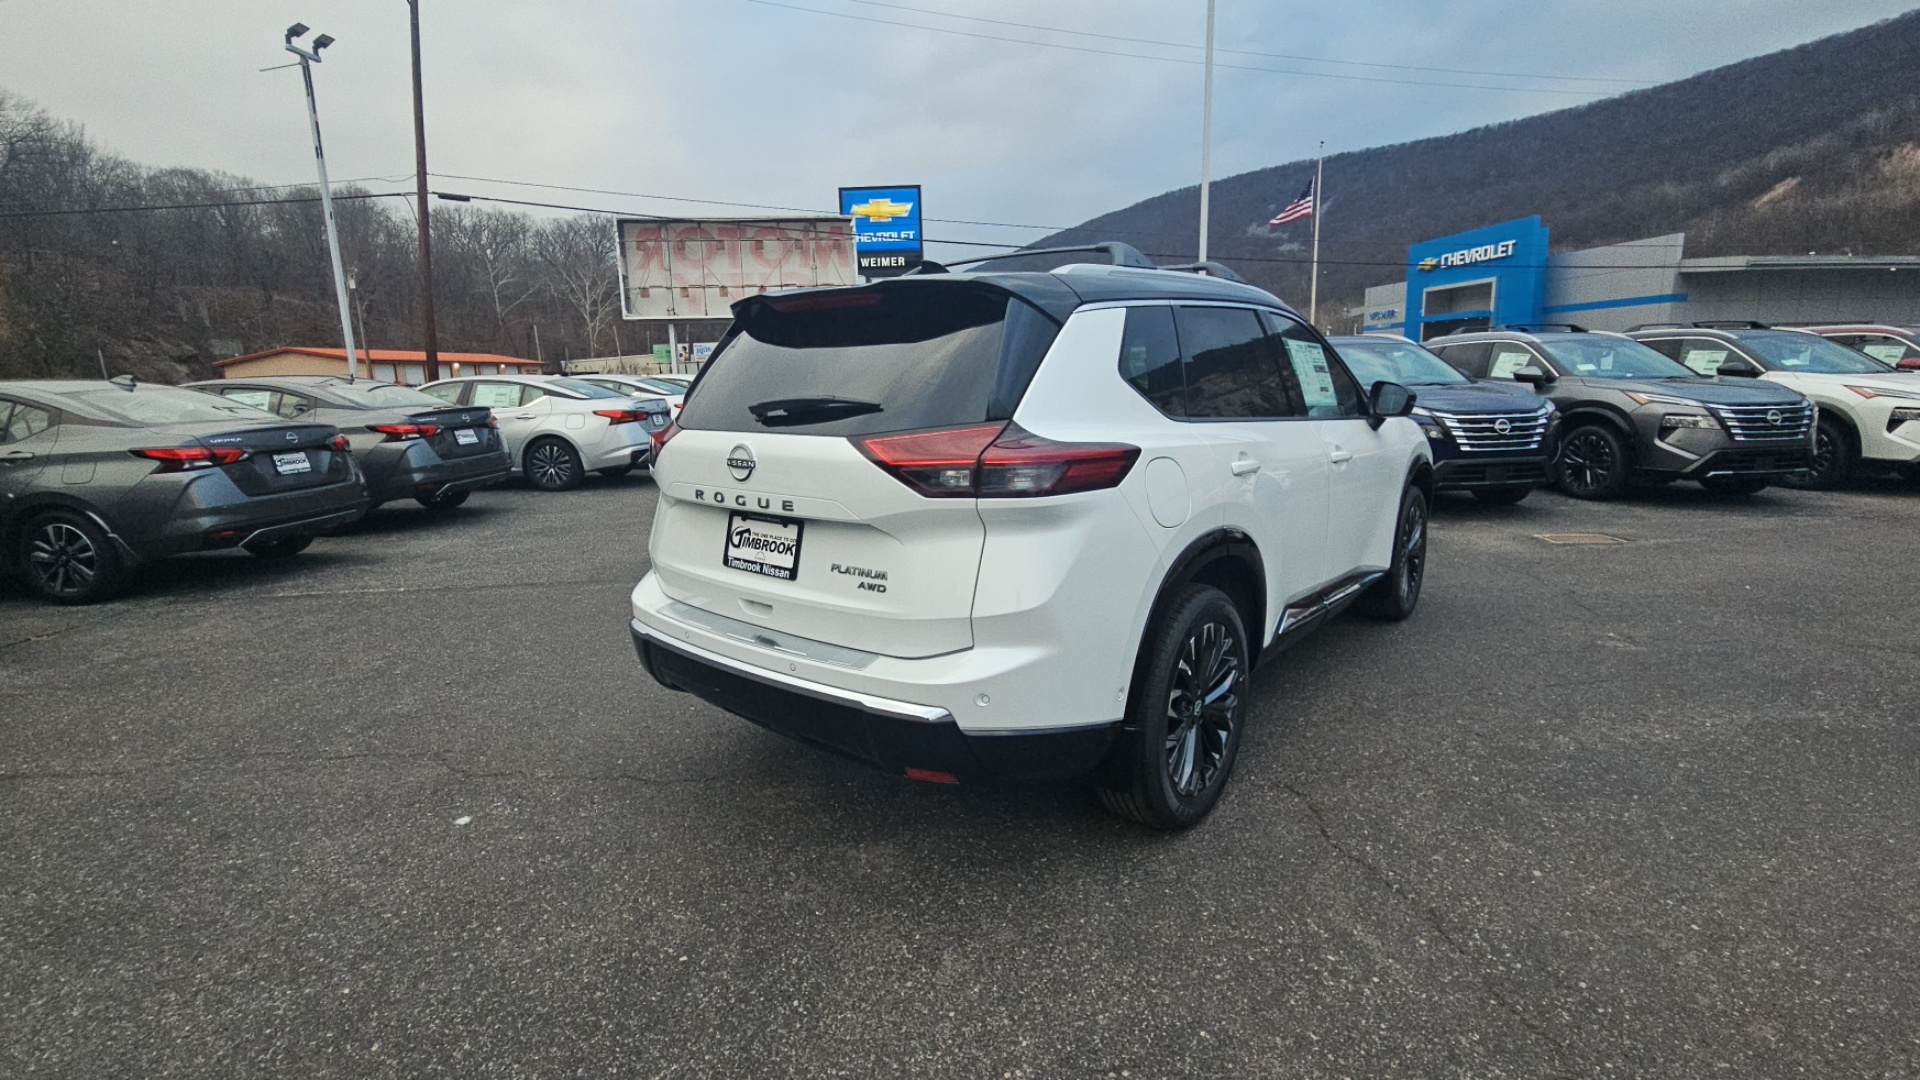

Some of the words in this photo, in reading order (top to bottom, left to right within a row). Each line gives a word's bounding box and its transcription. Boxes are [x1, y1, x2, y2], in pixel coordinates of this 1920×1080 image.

[856, 231, 915, 242] HEVROLET
[860, 257, 905, 267] WEIMER
[1440, 239, 1516, 268] CHEVROLET
[727, 459, 755, 468] NISSAN
[695, 489, 794, 511] ROGUE
[730, 526, 797, 557] TIMBROOK
[728, 557, 761, 573] Timbrook
[762, 564, 790, 579] Nissan
[830, 563, 888, 581] PLATINUM
[857, 581, 887, 593] AWD
